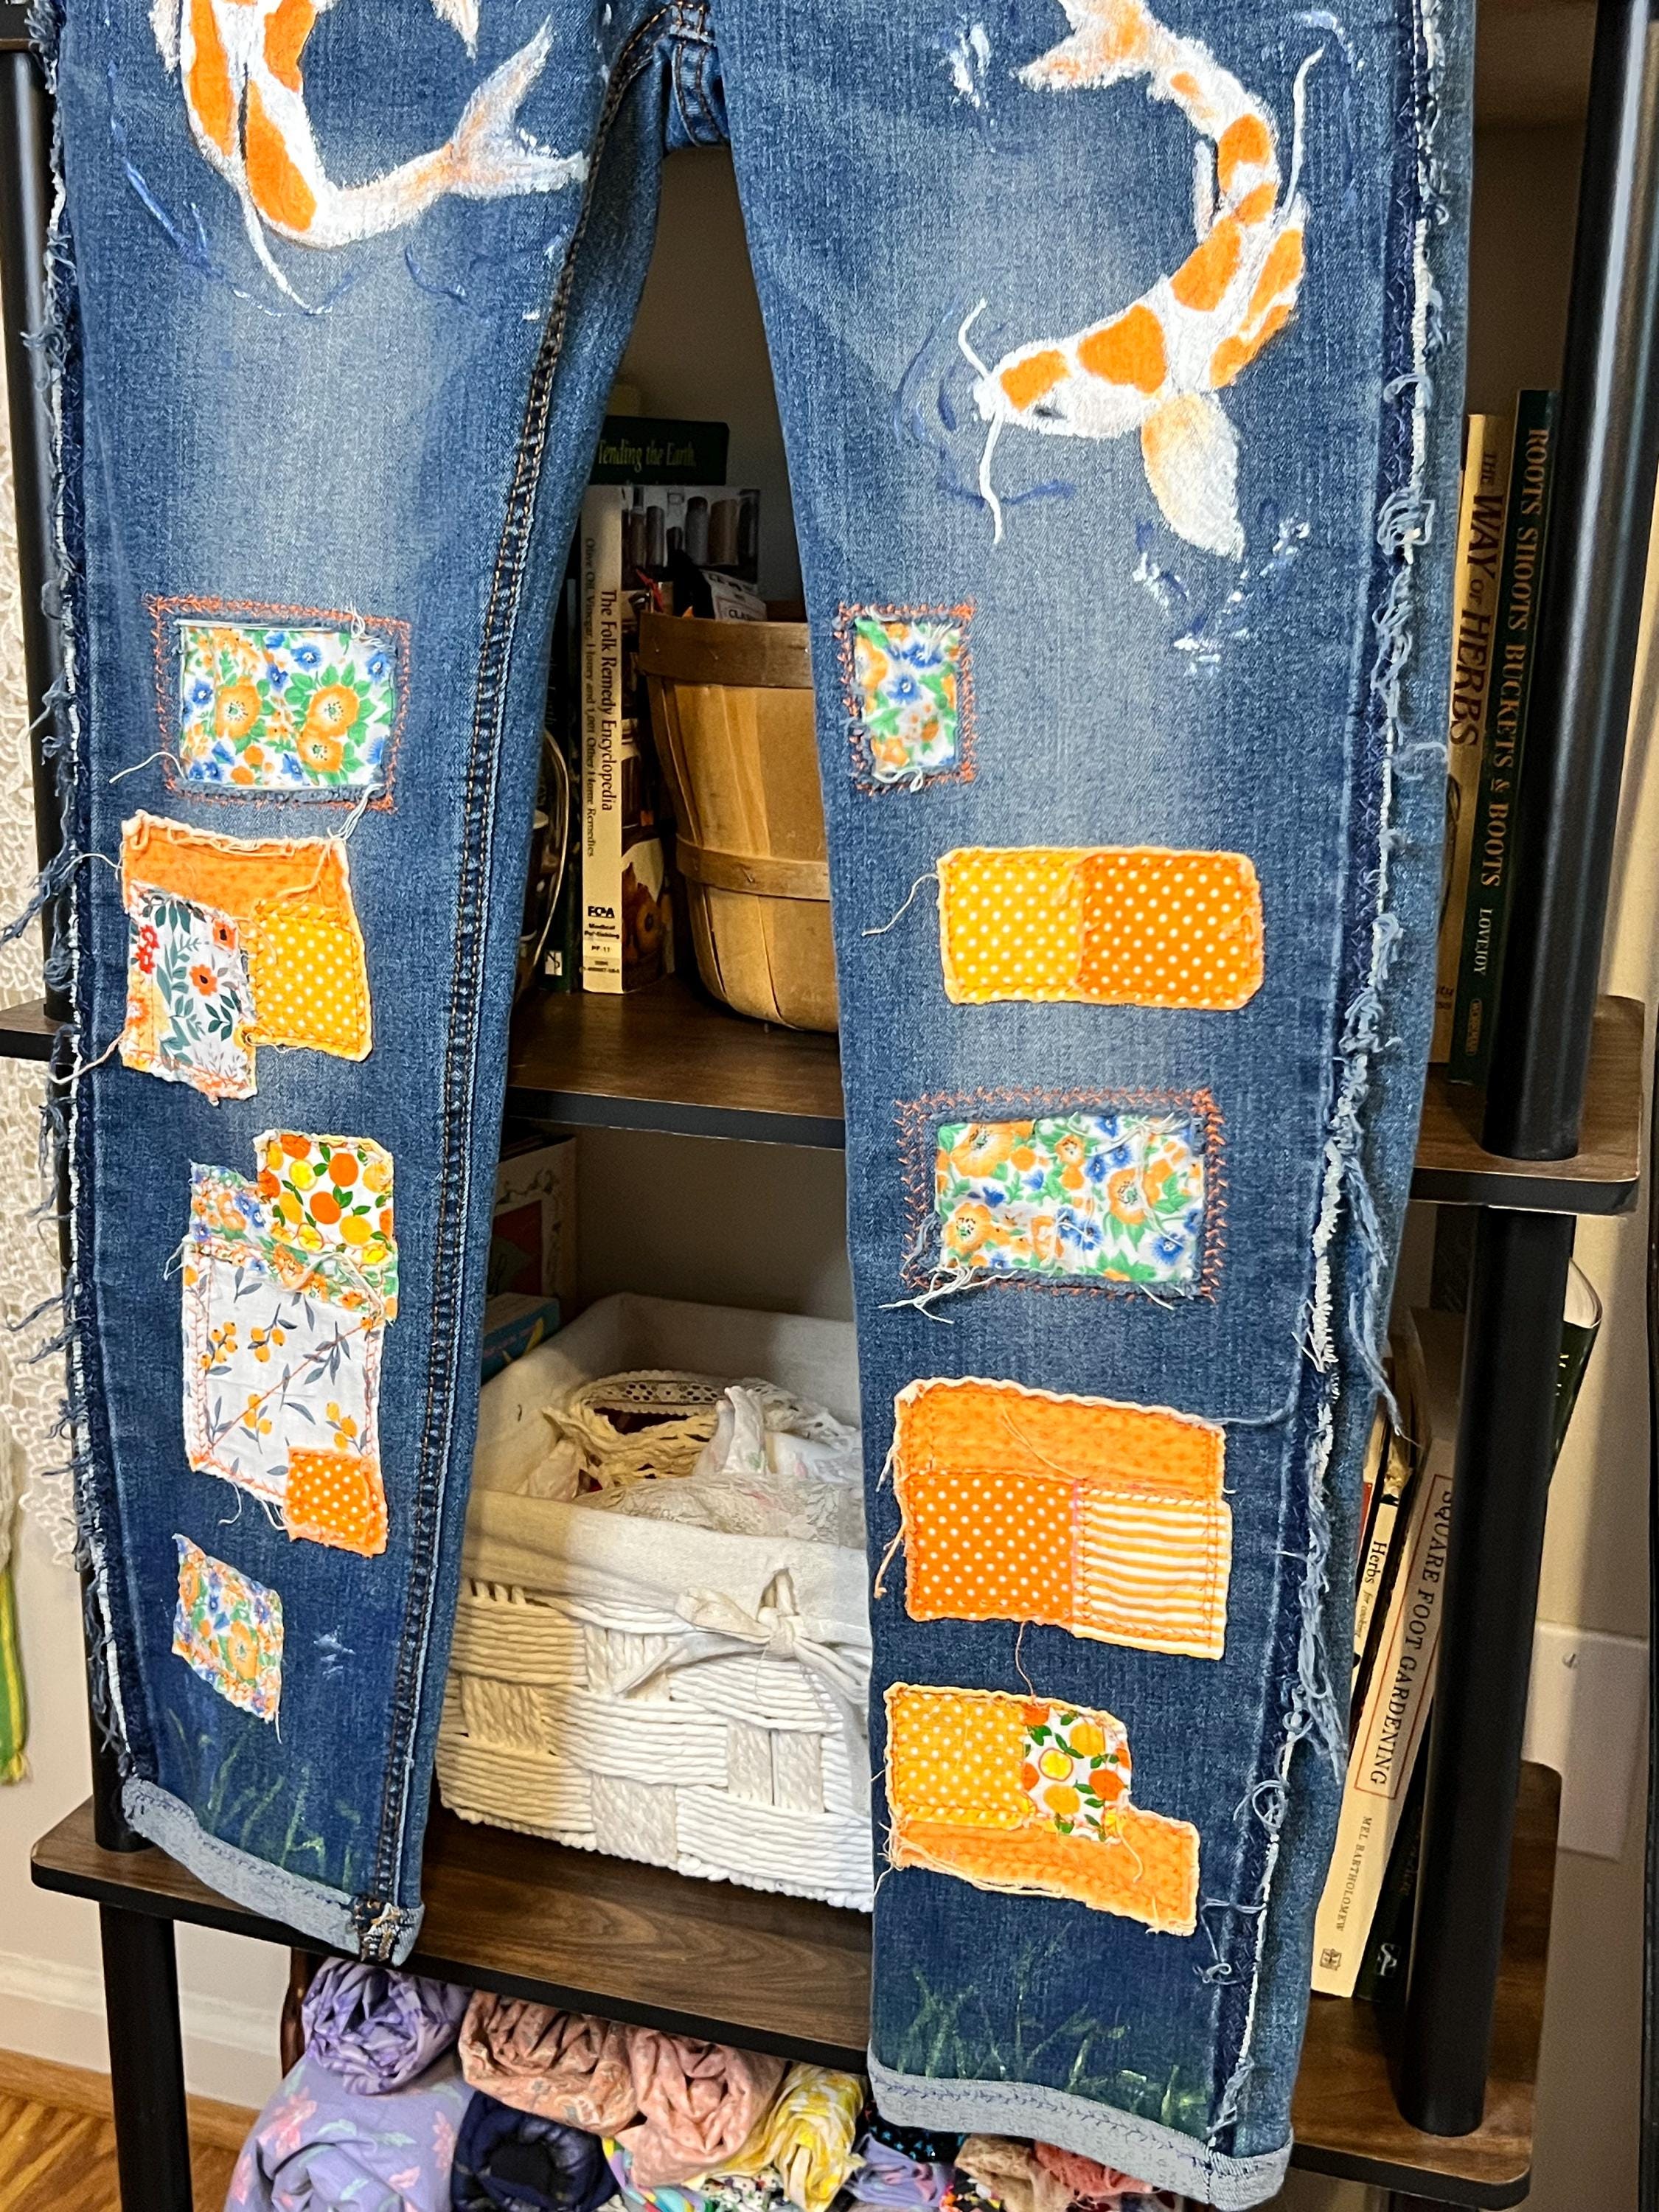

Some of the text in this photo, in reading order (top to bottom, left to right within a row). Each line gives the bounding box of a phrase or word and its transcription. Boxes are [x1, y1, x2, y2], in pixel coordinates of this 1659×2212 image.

[646, 439, 664, 465] the
[585, 538, 596, 567] Olive
[1450, 453, 1505, 746] THE WAY OF HERBS
[1482, 429, 1548, 886] ROOTS SHOOTS BUCKETS & BOOTS
[585, 684, 596, 703] and
[598, 590, 618, 812] The Folk Remedy Encyclopedia
[586, 737, 597, 768] Other
[586, 771, 597, 804] Home
[586, 807, 597, 857] Remedies
[1474, 908, 1493, 975] LOVEJOY
[1364, 1540, 1388, 1584] Herbs
[1422, 1491, 1452, 1584] SQUARE
[1363, 1589, 1374, 1604] for
[1405, 1588, 1435, 1650] FOOT
[1370, 1655, 1418, 1786] GARDENING
[1336, 1815, 1373, 1933] MEL BARTHOLOMEW
